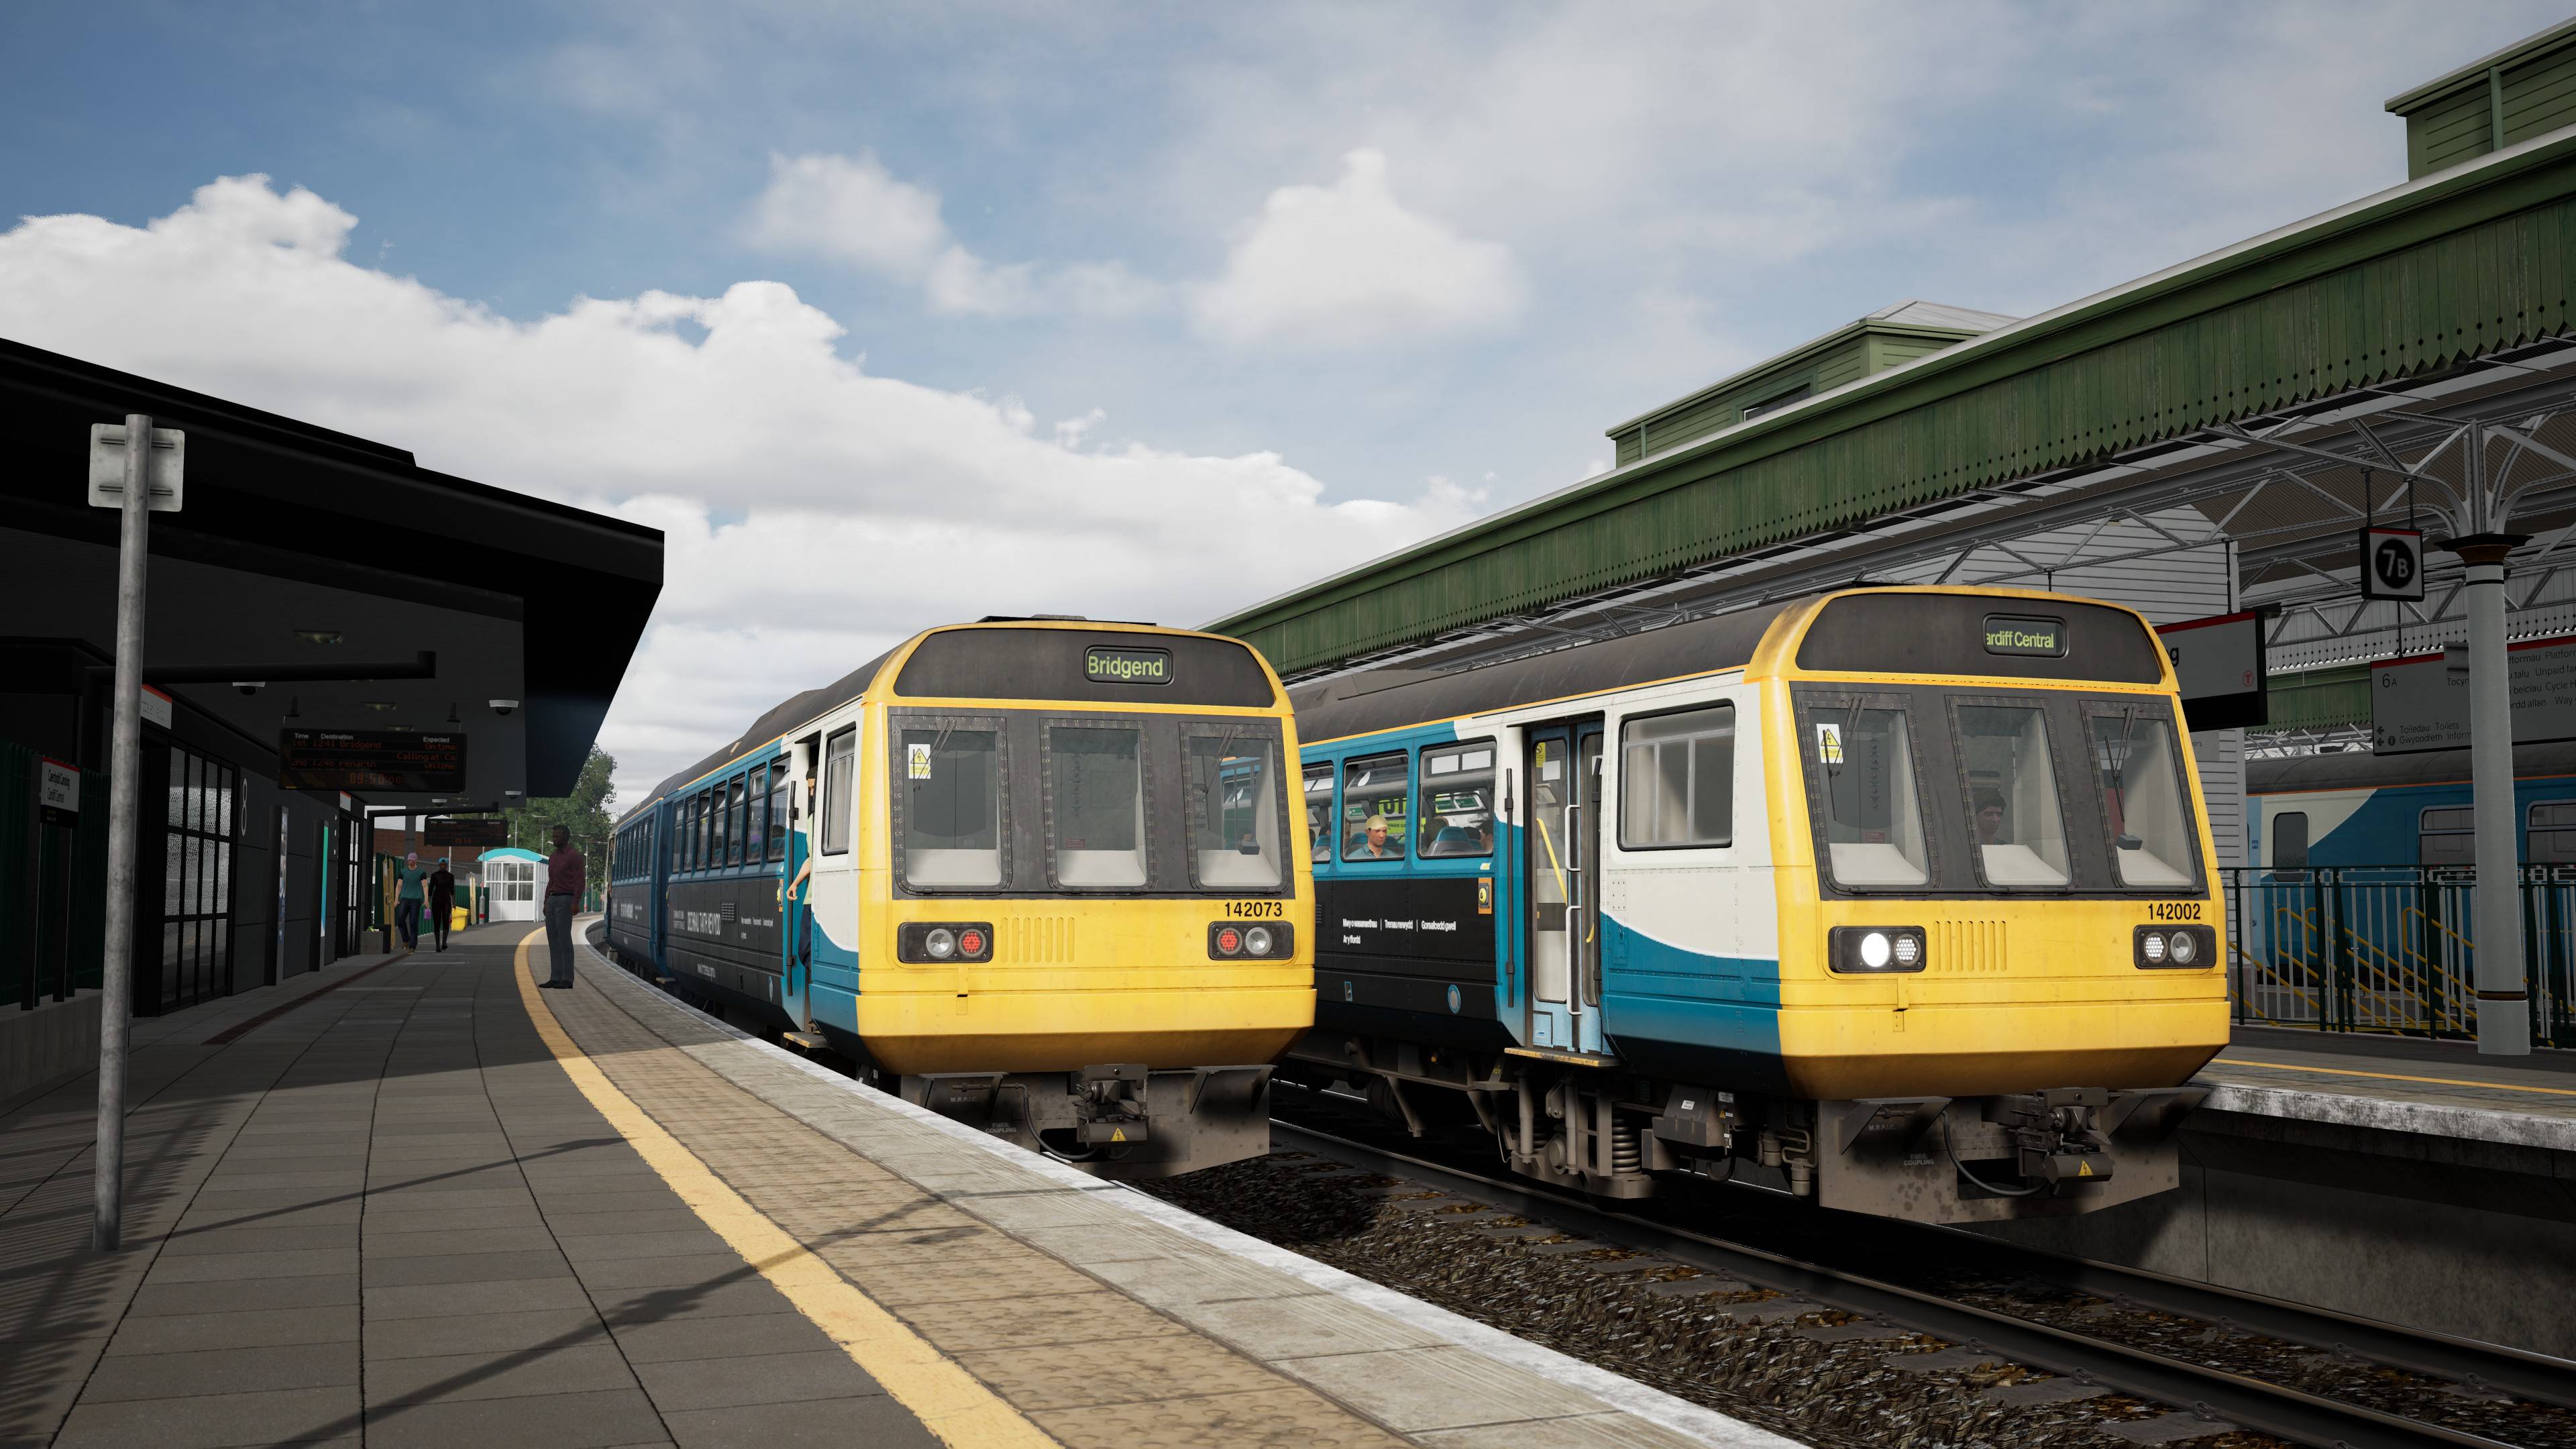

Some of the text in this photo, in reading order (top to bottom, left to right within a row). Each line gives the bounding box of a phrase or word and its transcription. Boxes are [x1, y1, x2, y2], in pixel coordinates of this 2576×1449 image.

[2382, 549, 2409, 578] 7B
[1986, 631, 2054, 648] ardiff Central
[1088, 655, 1163, 679] Bridgend
[2508, 654, 2541, 664] fformau
[2447, 677, 2469, 687] Tocyn
[2535, 665, 2565, 677] Unpaid
[2545, 681, 2569, 692] Cycle
[2510, 700, 2526, 709] ordd
[2555, 696, 2573, 706] Way
[2434, 722, 2459, 731] Toilets
[321, 733, 354, 741] Destination
[423, 736, 450, 744] Expected
[241, 778, 248, 837] 8
[1225, 902, 1282, 917] 142073
[2149, 903, 2200, 920] 142002
